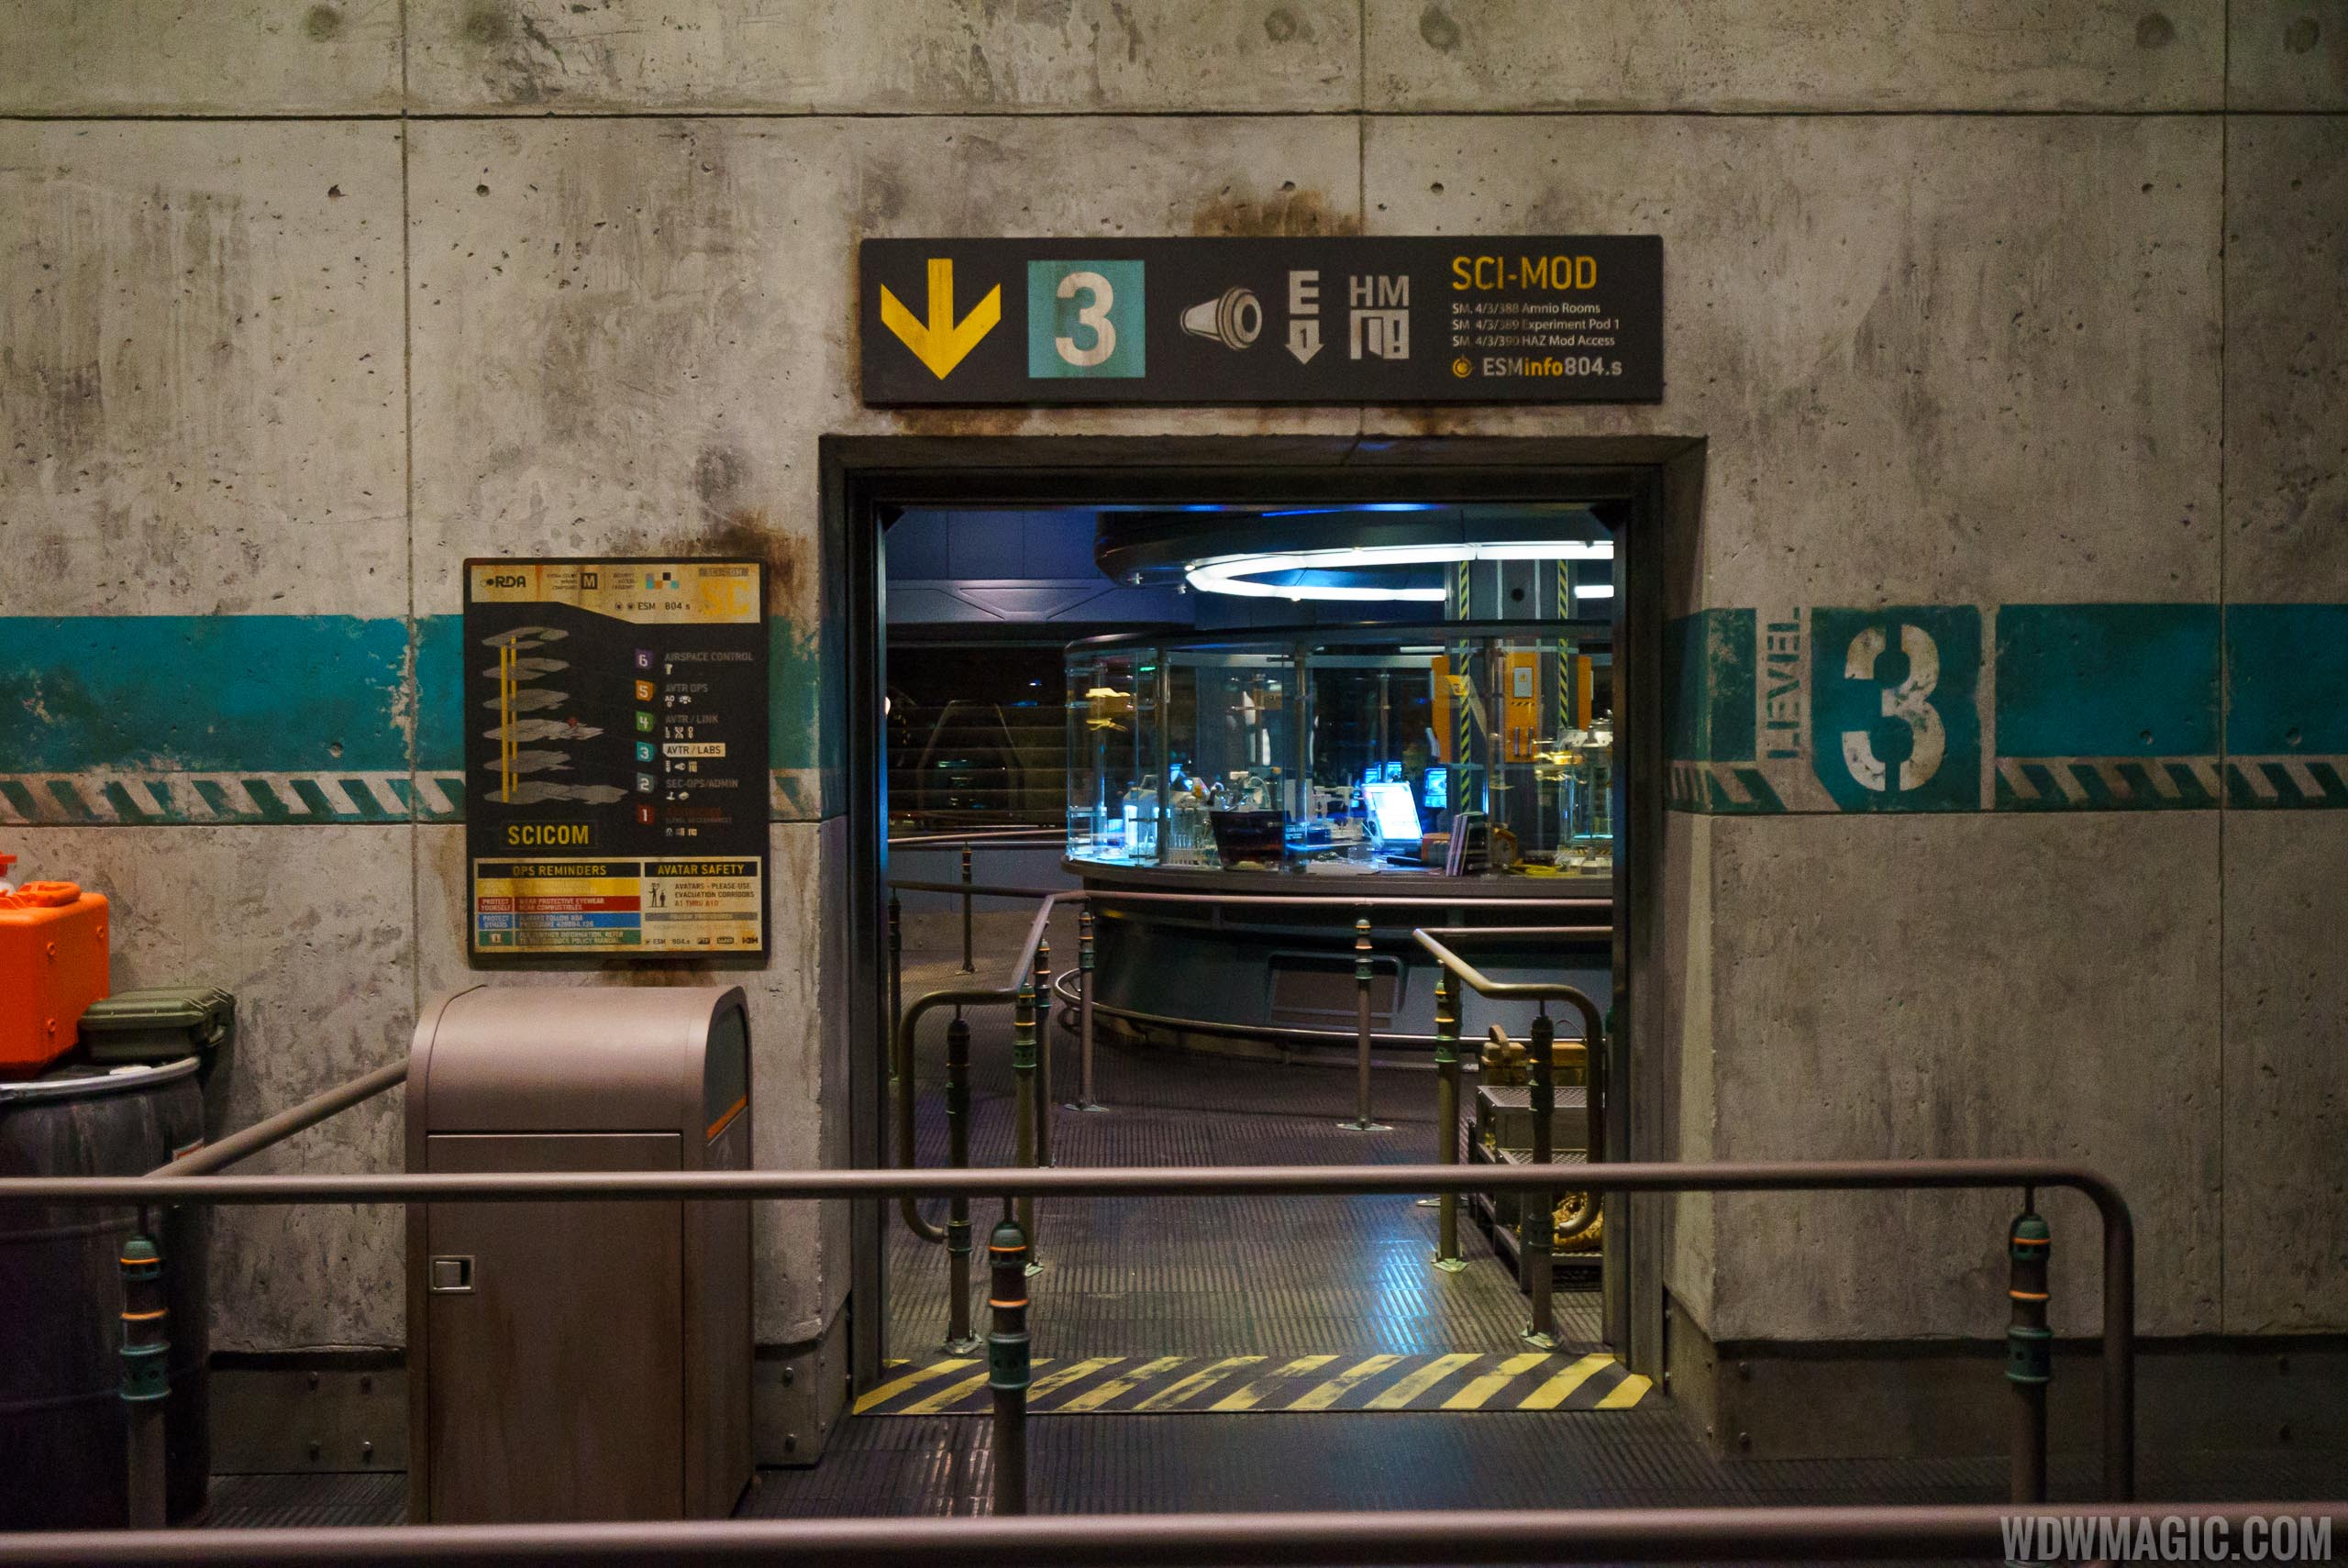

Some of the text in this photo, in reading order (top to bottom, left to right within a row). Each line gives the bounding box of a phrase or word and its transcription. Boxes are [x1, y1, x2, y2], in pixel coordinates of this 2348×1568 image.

[1452, 256, 1597, 290] SCI-MOD
[1290, 271, 1319, 314] E
[1350, 276, 1409, 307] HM
[1523, 302, 1559, 314] Amnio
[1562, 302, 1600, 314] Rooms
[1055, 271, 1116, 366] 3
[1523, 318, 1586, 332] Experiment
[1589, 317, 1611, 329] Pod
[1614, 318, 1620, 329] 1
[1523, 335, 1546, 347] HAZ
[1549, 334, 1575, 347] Mod
[1578, 335, 1615, 347] Access
[1483, 357, 1623, 377] ESMinfo804.s
[495, 575, 526, 588] RDA
[583, 575, 595, 588] M
[700, 579, 750, 616] SC
[638, 602, 656, 611] ESM
[638, 654, 648, 668] 6
[665, 652, 753, 661] AIRSPACE CONTROL
[665, 683, 708, 693] AVTR OPS
[1767, 606, 1800, 759] LEVEL
[639, 685, 648, 698] 5
[1842, 624, 1945, 791] 3
[639, 715, 649, 730] 4
[666, 714, 689, 723] AVTR
[697, 714, 719, 723] LINK
[639, 746, 649, 759] 3
[667, 745, 689, 755] AVTR
[698, 745, 720, 755] LABS
[640, 778, 649, 790] 2
[642, 808, 648, 822] 1
[508, 824, 589, 845] SCICOM
[514, 866, 607, 876] OPS REMINDERS
[658, 864, 745, 875] AVATAR SAFETY
